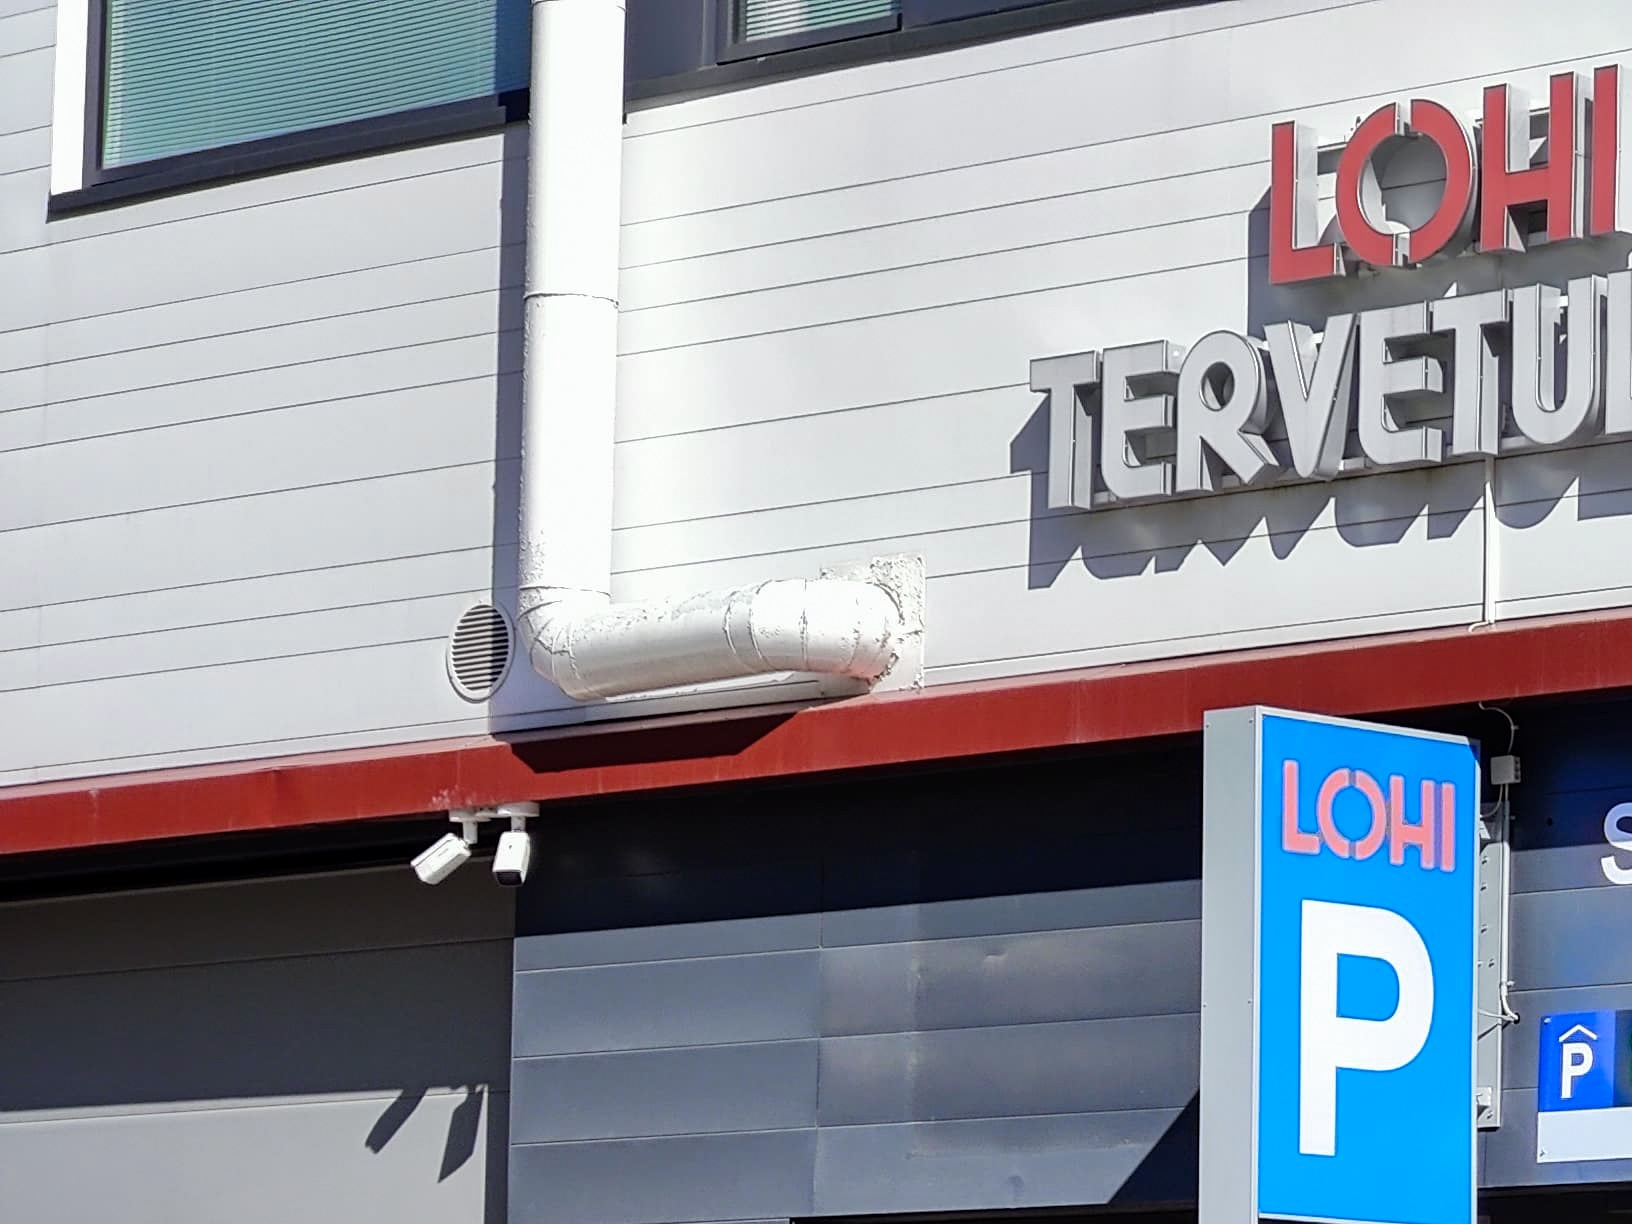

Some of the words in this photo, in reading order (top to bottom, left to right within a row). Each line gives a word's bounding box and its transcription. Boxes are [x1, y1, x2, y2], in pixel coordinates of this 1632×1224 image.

[1270, 64, 1622, 285] LOHI
[1282, 759, 1457, 873] LOHI
[1299, 898, 1435, 1157] P
[1560, 1041, 1594, 1099] P
